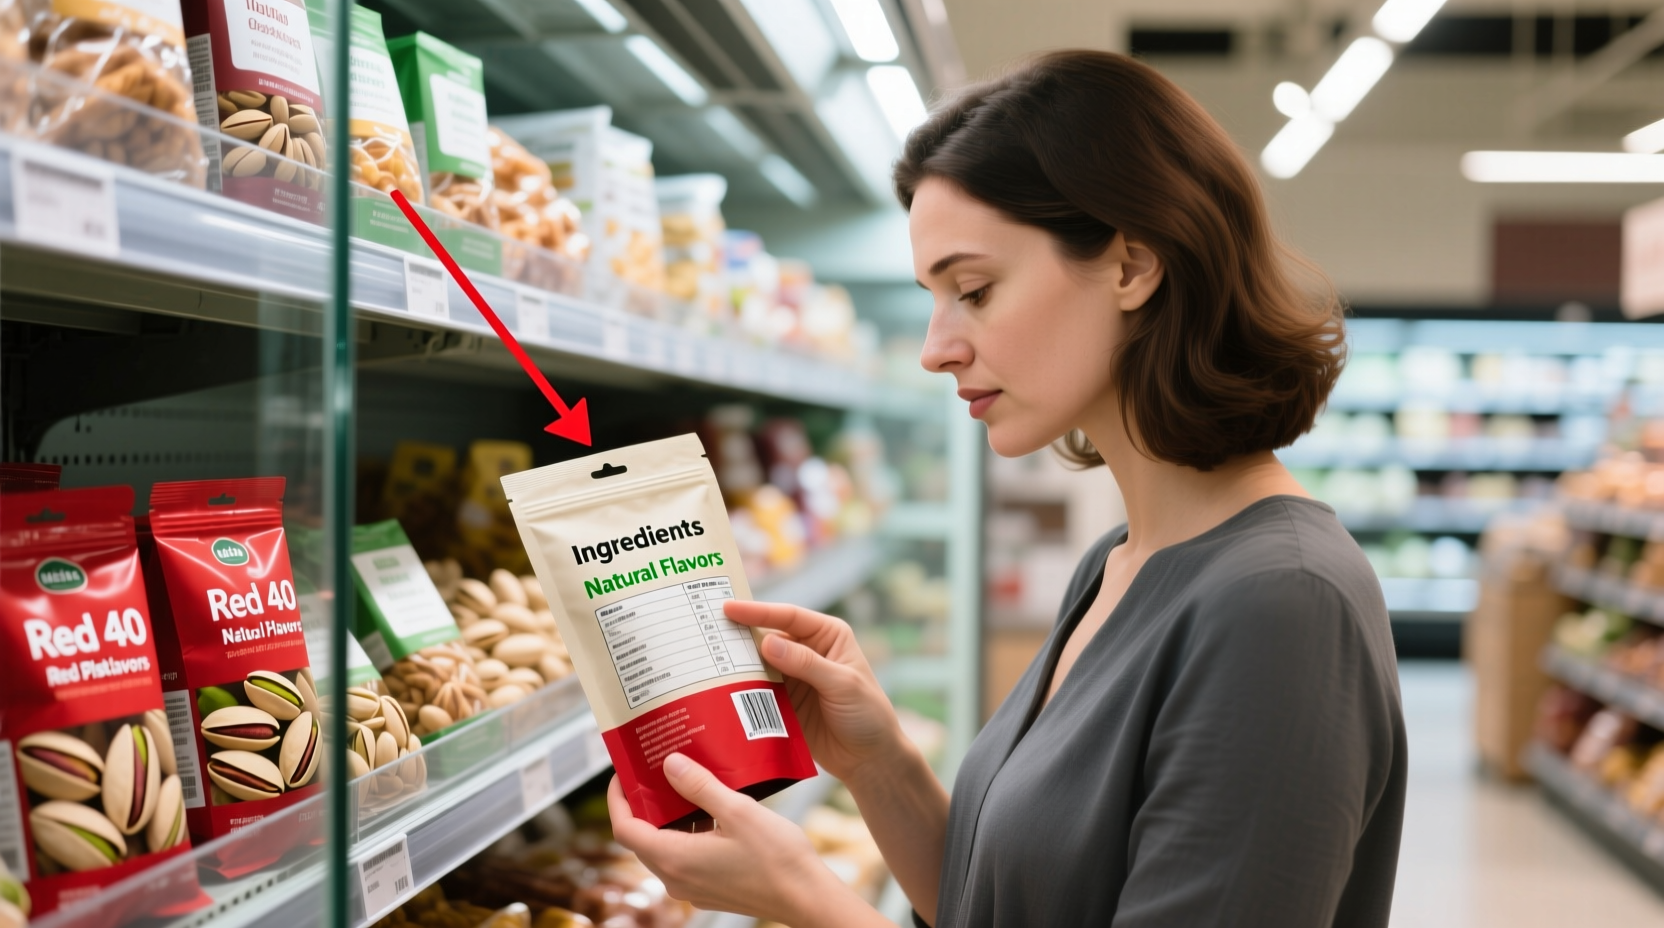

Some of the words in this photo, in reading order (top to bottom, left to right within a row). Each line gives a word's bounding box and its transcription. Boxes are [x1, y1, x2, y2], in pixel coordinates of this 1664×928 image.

[571, 519, 705, 565] Ingredients
[584, 562, 659, 599] Natural
[659, 552, 724, 576] Flavors
[207, 582, 264, 621] Red
[268, 580, 296, 611] 40
[23, 612, 100, 661] Red
[104, 607, 147, 647] 40
[46, 662, 81, 687] Red
